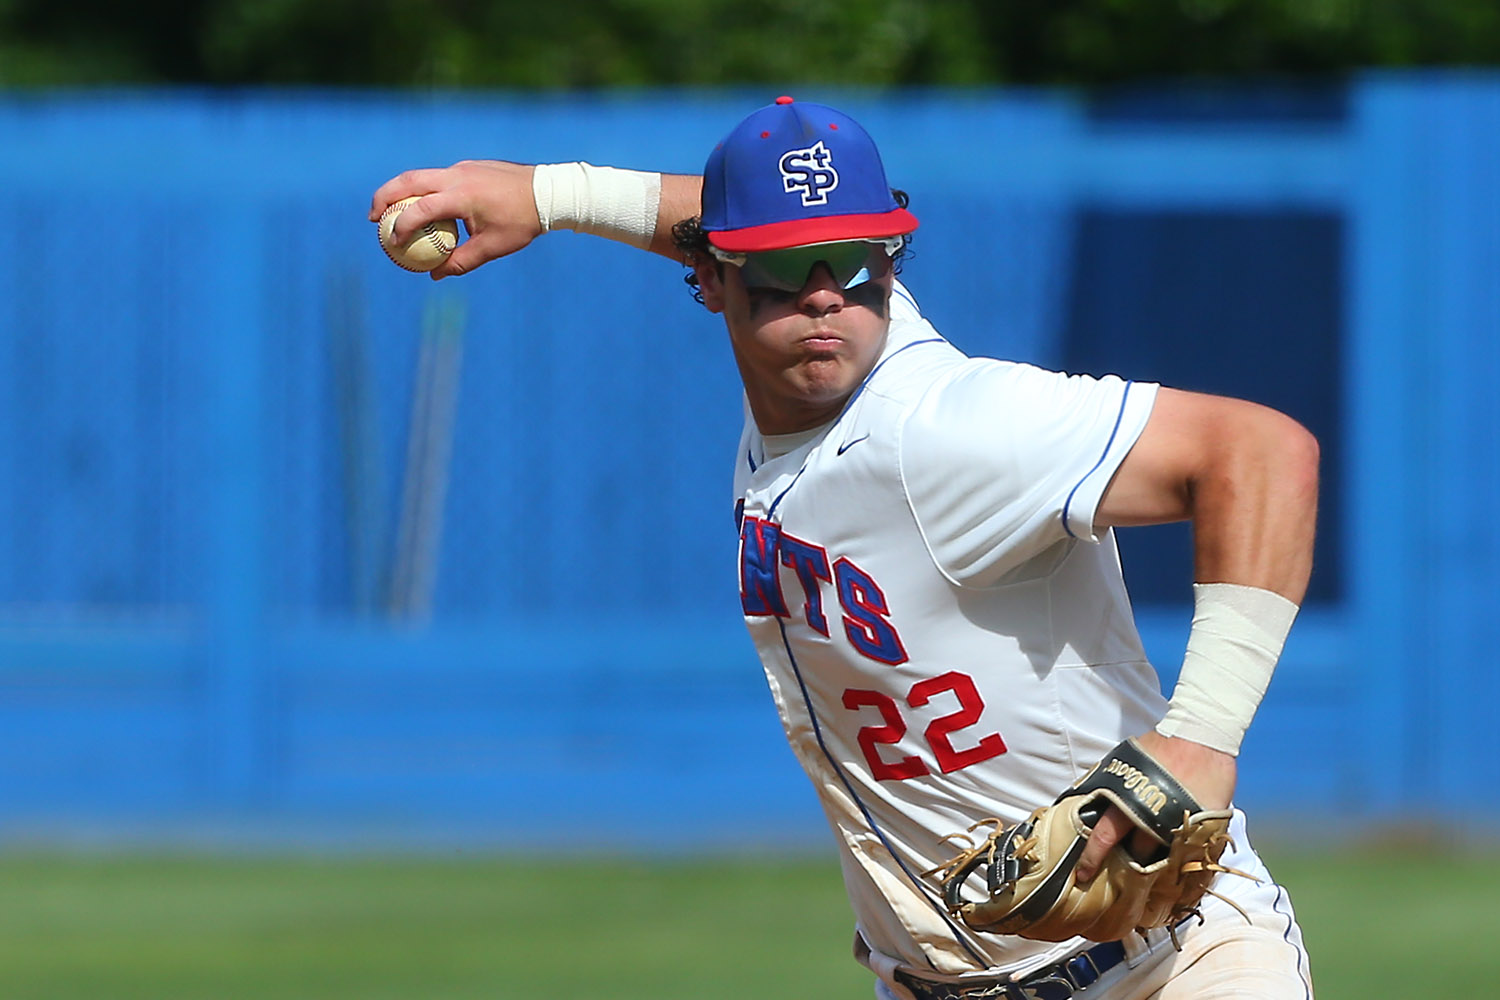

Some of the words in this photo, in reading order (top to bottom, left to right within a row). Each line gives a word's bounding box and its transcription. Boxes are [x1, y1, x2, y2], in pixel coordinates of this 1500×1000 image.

[735, 499, 910, 666] NTS
[841, 670, 1008, 782] 22
[1106, 758, 1167, 816] Wilson
